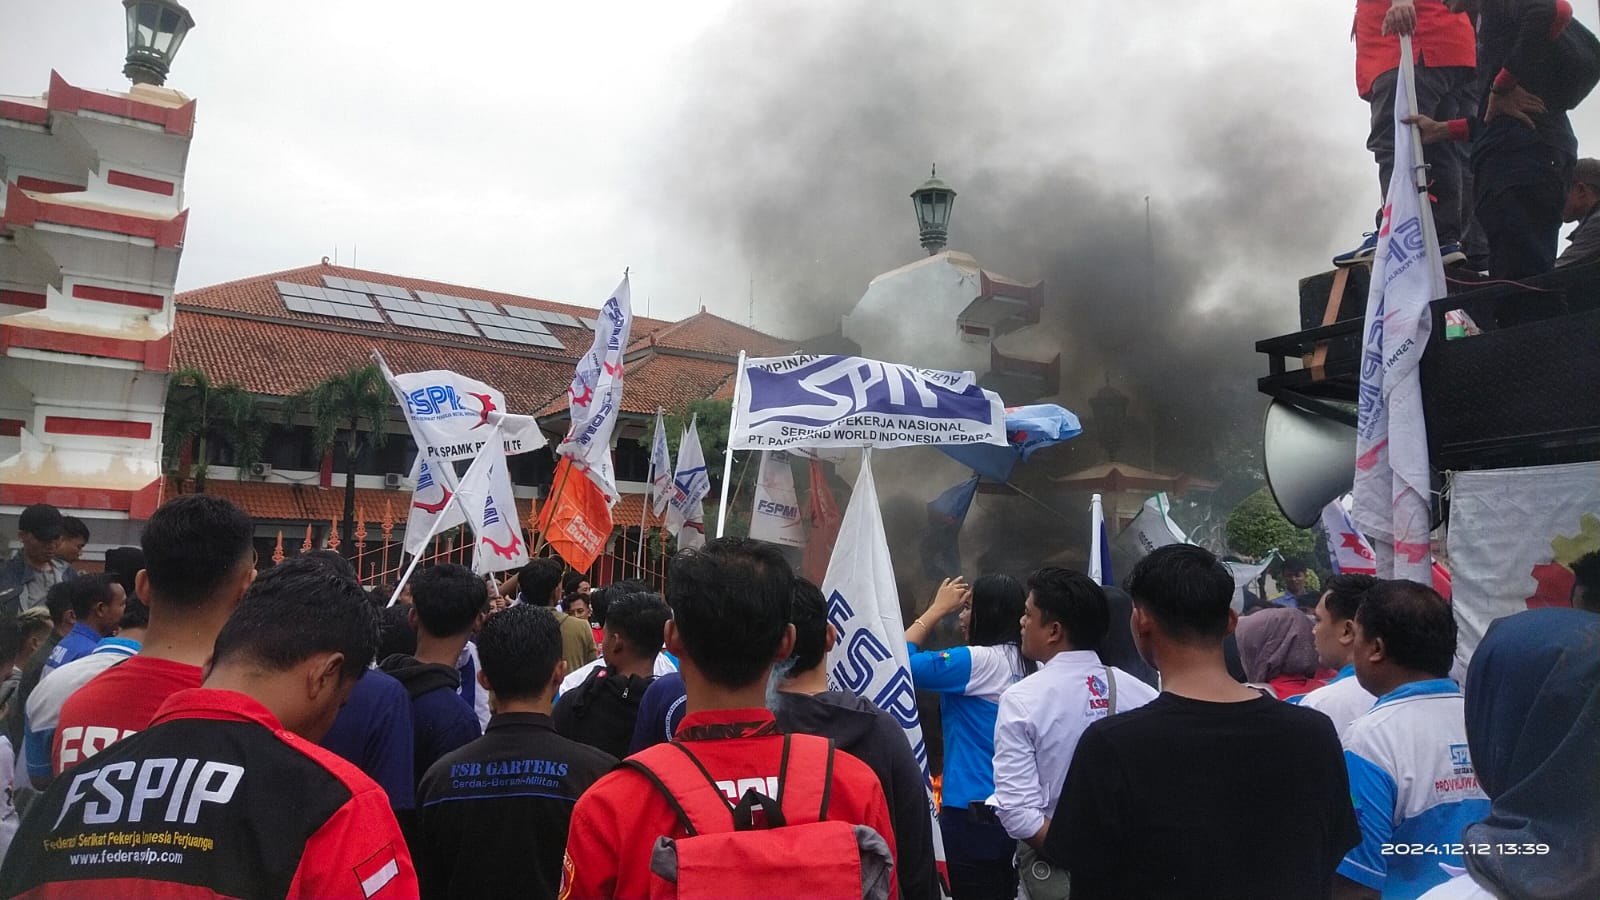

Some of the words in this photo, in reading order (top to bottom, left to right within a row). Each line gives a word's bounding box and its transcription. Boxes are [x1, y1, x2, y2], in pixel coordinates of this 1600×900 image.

[898, 419, 966, 432] NASIONAL
[748, 434, 765, 445] PT.
[834, 429, 877, 441] WORLD
[879, 431, 942, 444] INDONESIA
[440, 443, 473, 457] SPAMK
[757, 499, 798, 518] FSPMI
[486, 759, 568, 777] GARTEKS
[52, 757, 245, 832] FSPIP
[108, 830, 141, 848] Pekerja
